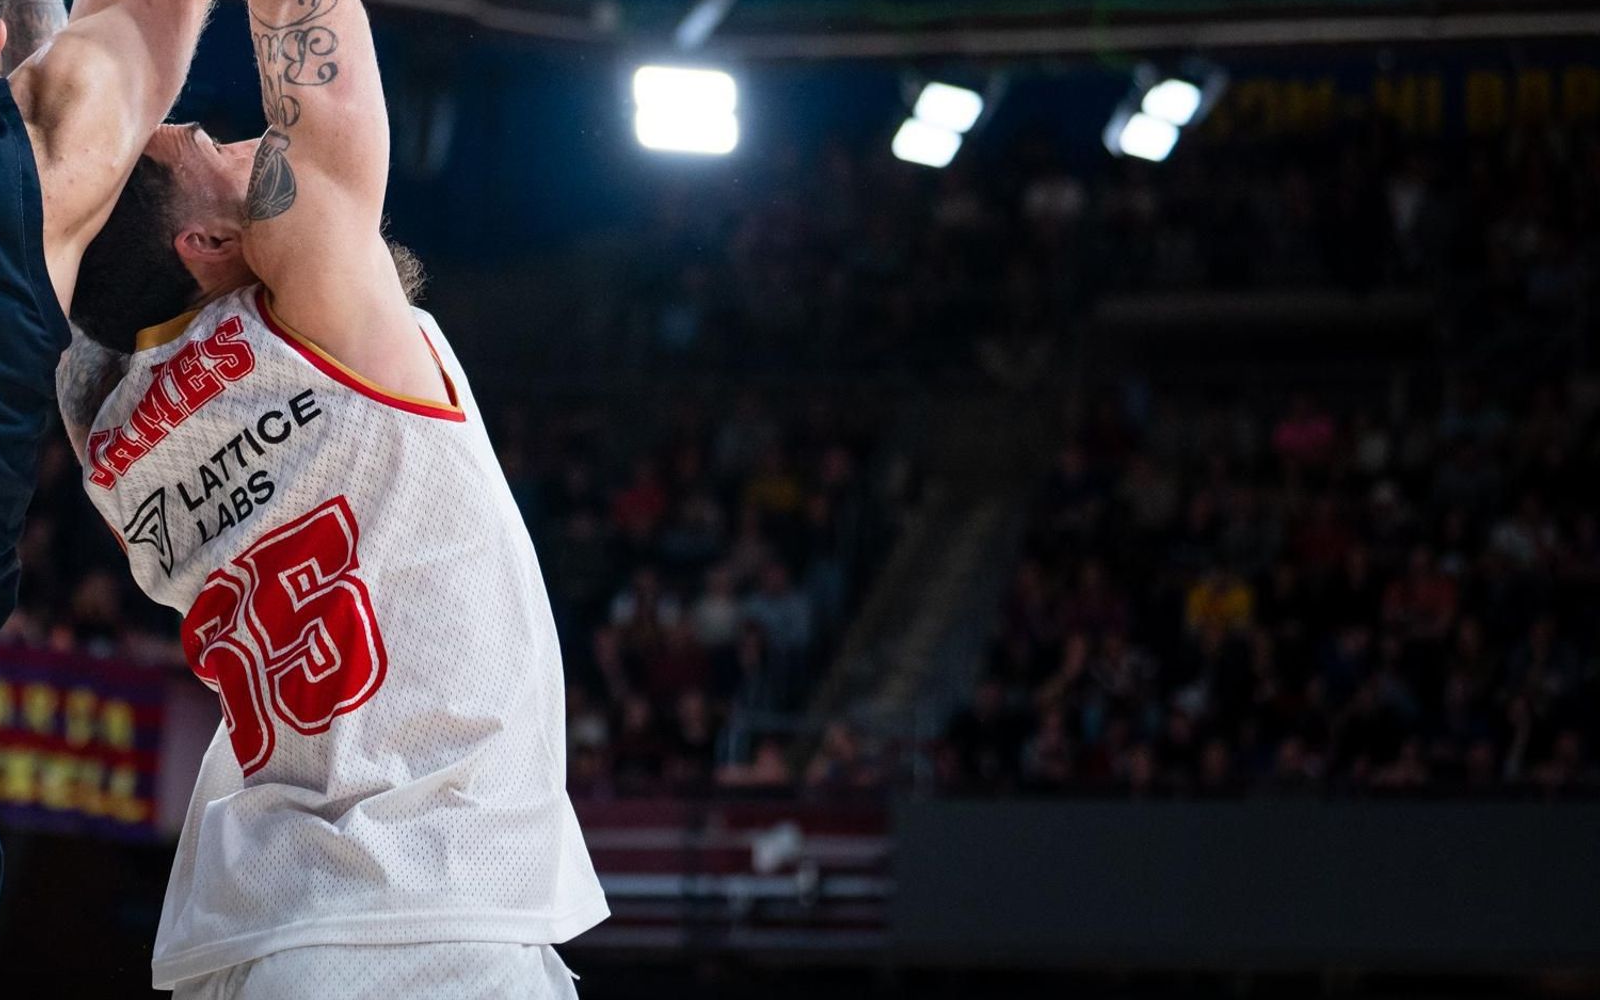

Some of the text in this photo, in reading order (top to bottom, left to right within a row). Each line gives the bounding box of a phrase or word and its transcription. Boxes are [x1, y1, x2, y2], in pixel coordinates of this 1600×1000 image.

[88, 315, 255, 490] JAMES
[177, 388, 322, 512] LATTICE
[196, 470, 276, 544] LABS
